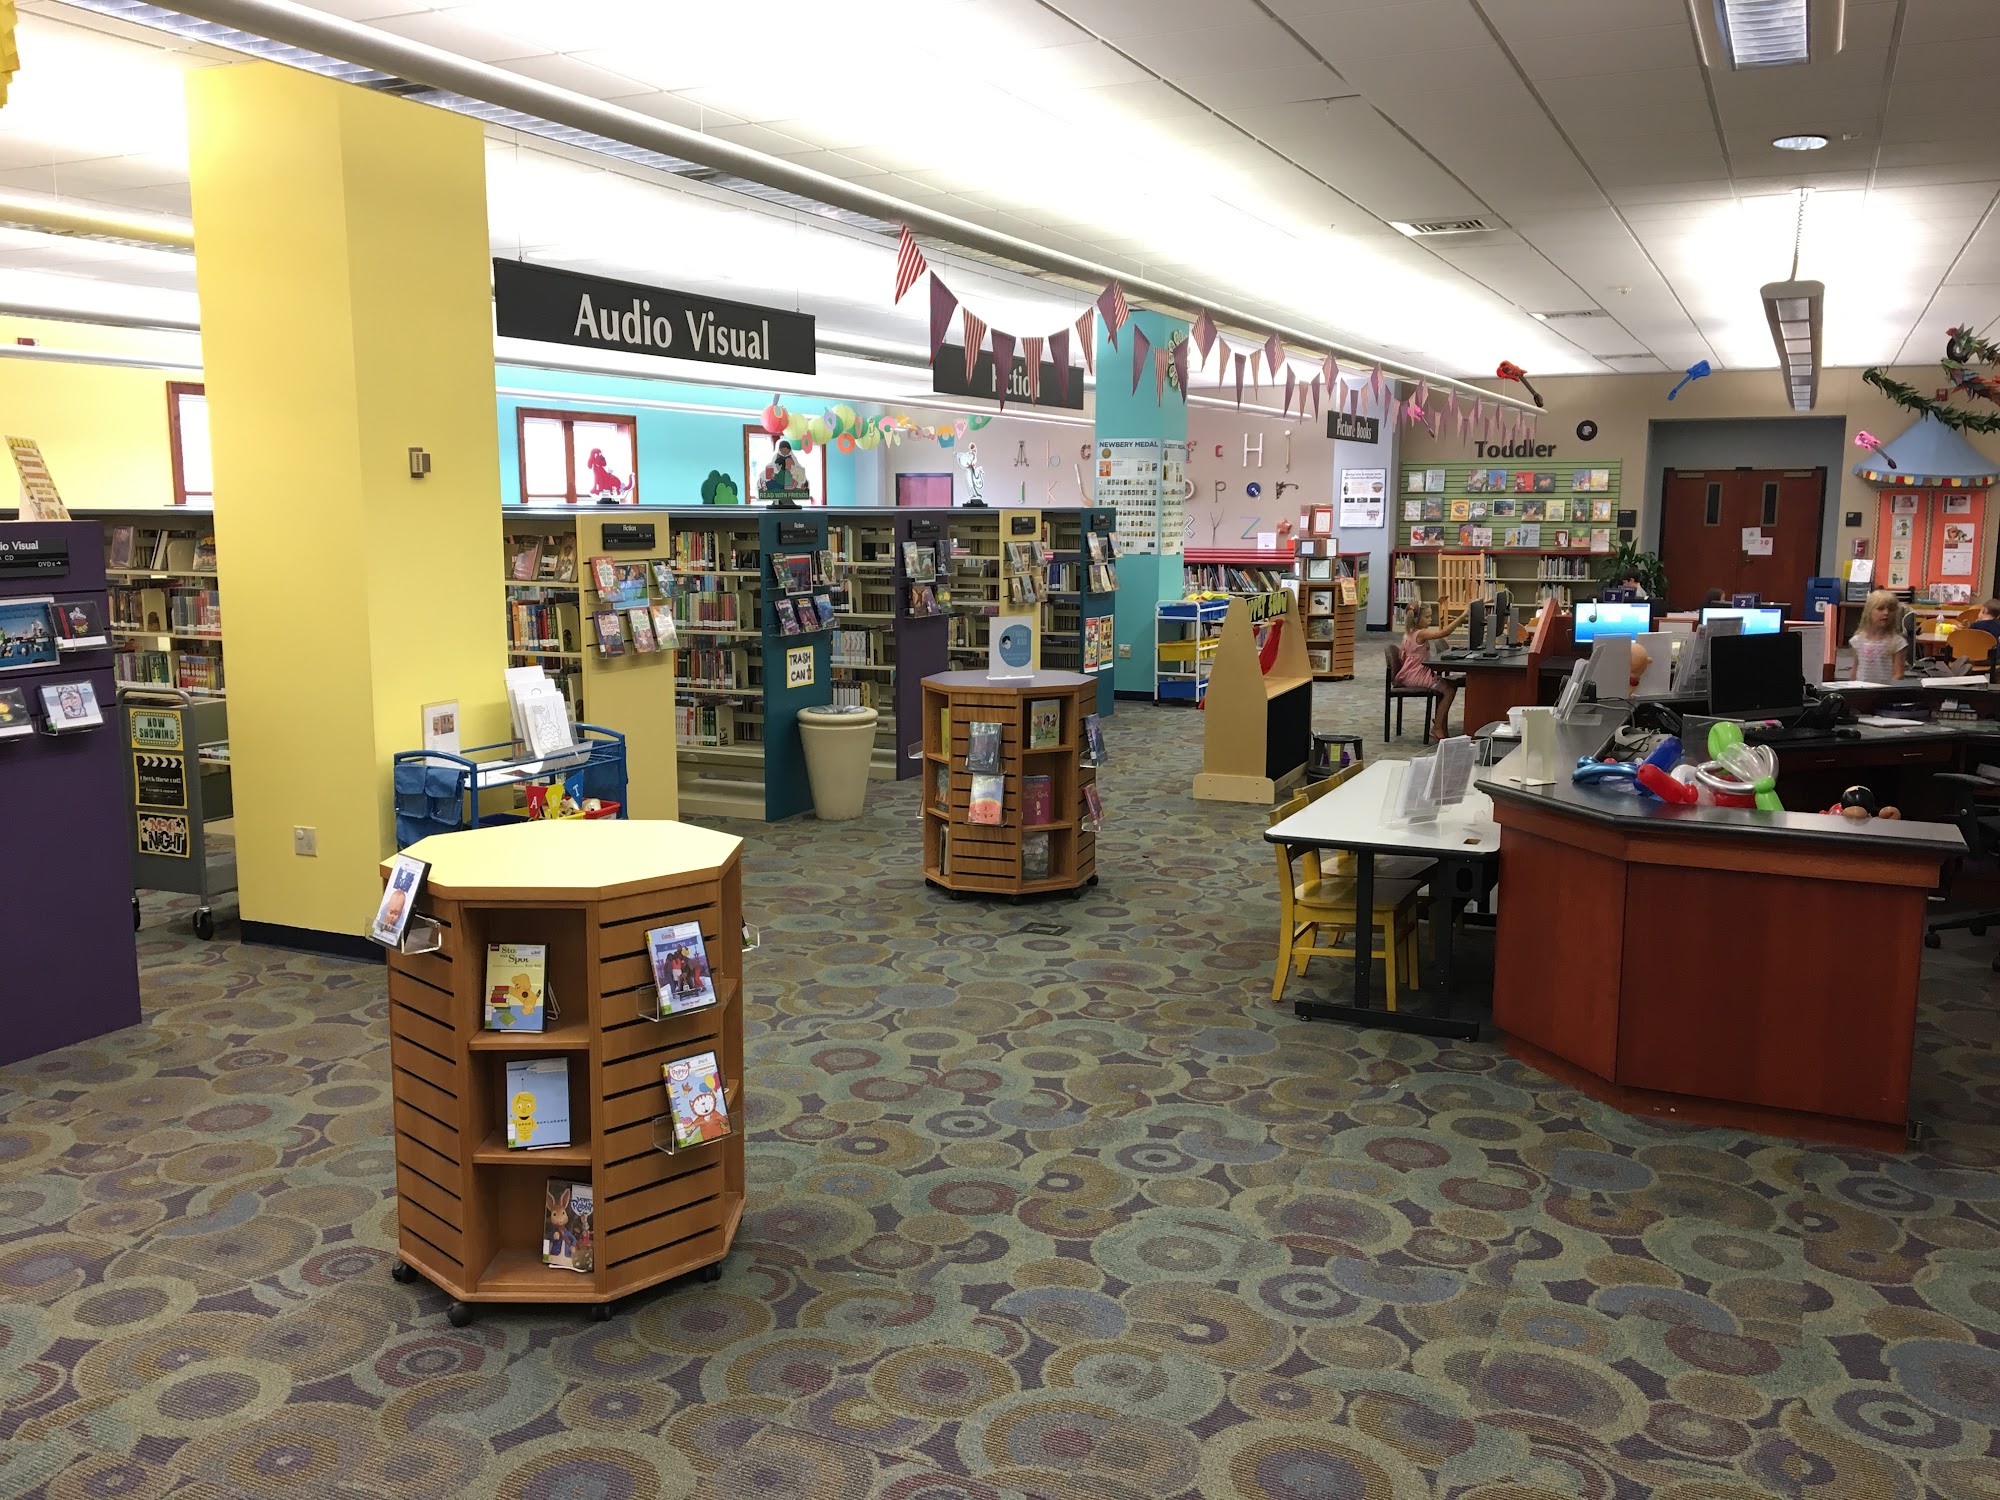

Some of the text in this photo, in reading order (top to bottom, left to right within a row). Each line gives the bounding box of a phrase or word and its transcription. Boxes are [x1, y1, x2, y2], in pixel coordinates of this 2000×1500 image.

[574, 293, 770, 361] Audio Visual
[1356, 421, 1372, 440] Books
[1474, 439, 1557, 458] Toddler
[11, 539, 39, 550] Visual
[1610, 593, 1616, 601] 3
[1740, 599, 1746, 607] 2
[788, 652, 811, 667] TRASH
[790, 670, 806, 682] CAN
[147, 718, 165, 728] NOW
[139, 728, 175, 740] SHOWING
[672, 1068, 688, 1077] Poppy
